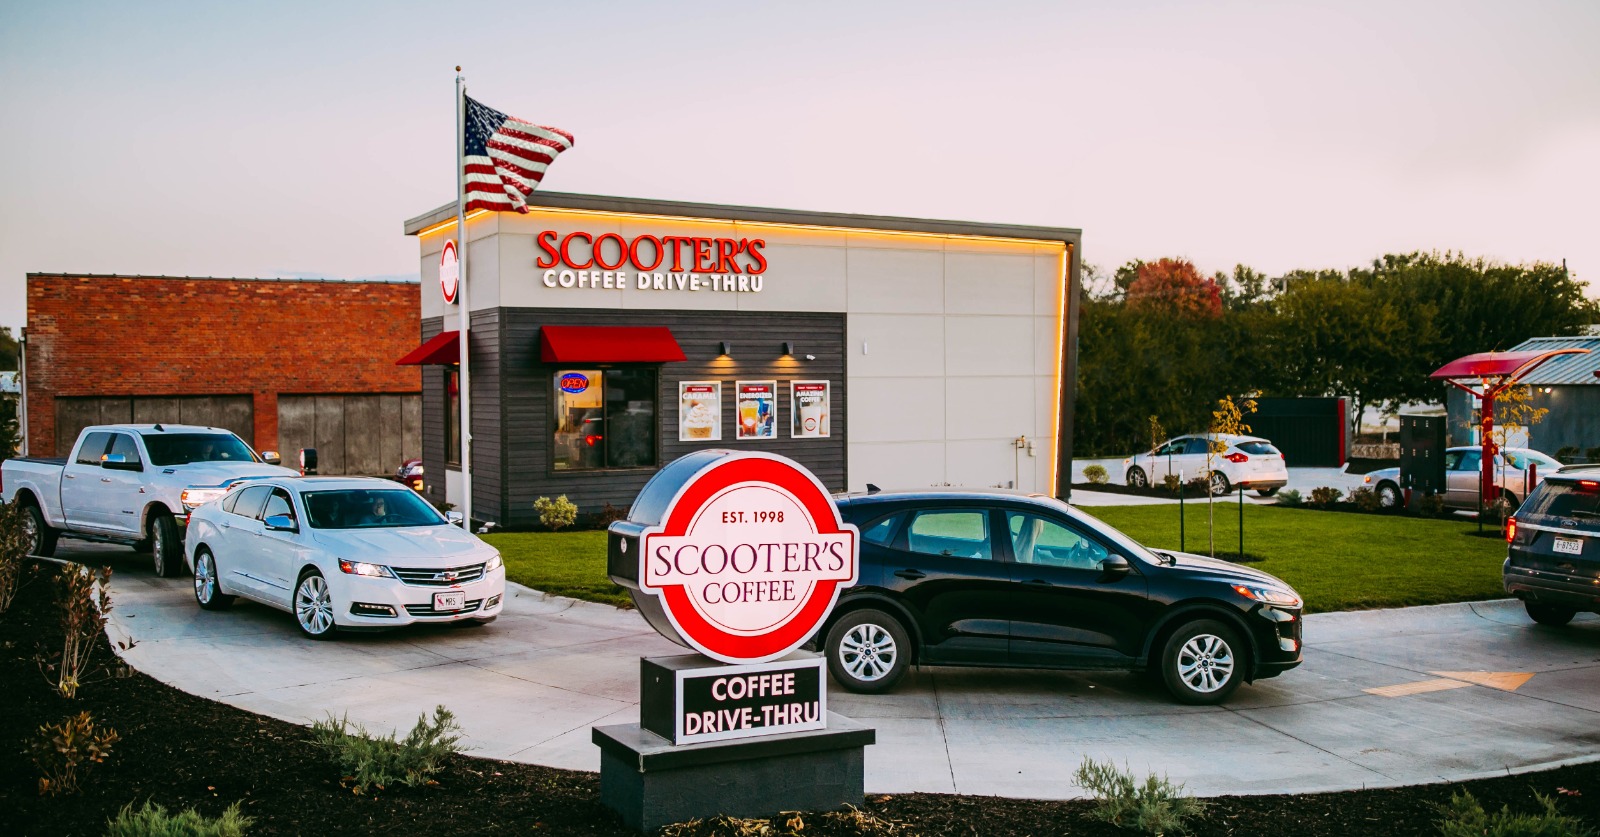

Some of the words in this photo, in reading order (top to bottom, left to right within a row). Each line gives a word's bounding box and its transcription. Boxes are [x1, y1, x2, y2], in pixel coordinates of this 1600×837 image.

[537, 230, 768, 274] SCOOTER'S
[542, 269, 626, 289] COFFEE
[637, 273, 763, 292] DRIVE-THRU
[561, 377, 587, 389] OPEN
[796, 390, 824, 398] AMAZING
[682, 392, 717, 400] CARAMEL
[722, 511, 748, 523] EST.
[753, 511, 785, 523] 1998
[654, 541, 844, 577] SCOOTER'S
[445, 597, 456, 605] MRS
[702, 580, 796, 604] COFFEE
[711, 672, 796, 701] COFFEE
[685, 701, 819, 735] DRIVE-THRU
